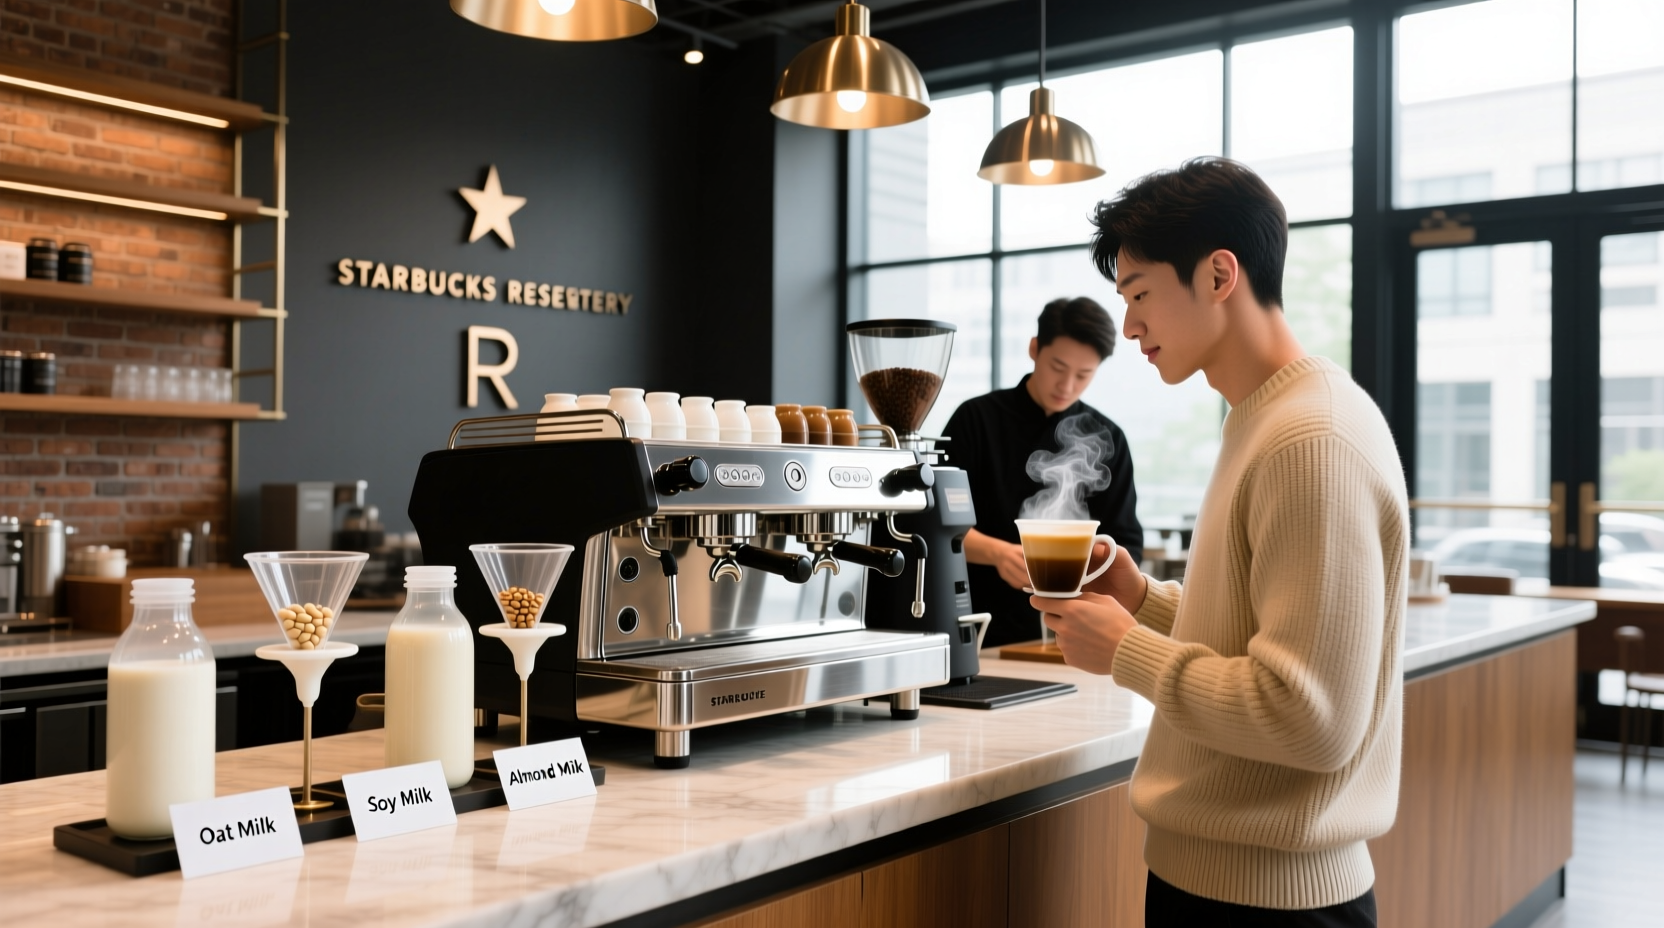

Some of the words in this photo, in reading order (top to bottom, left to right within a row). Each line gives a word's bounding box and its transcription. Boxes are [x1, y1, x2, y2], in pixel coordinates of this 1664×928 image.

[337, 257, 497, 302] STARBUCKS
[467, 325, 519, 410] R
[367, 795, 397, 814] Soy
[400, 786, 433, 807] Milk
[199, 823, 235, 845] Oat
[237, 815, 277, 839] Milk
